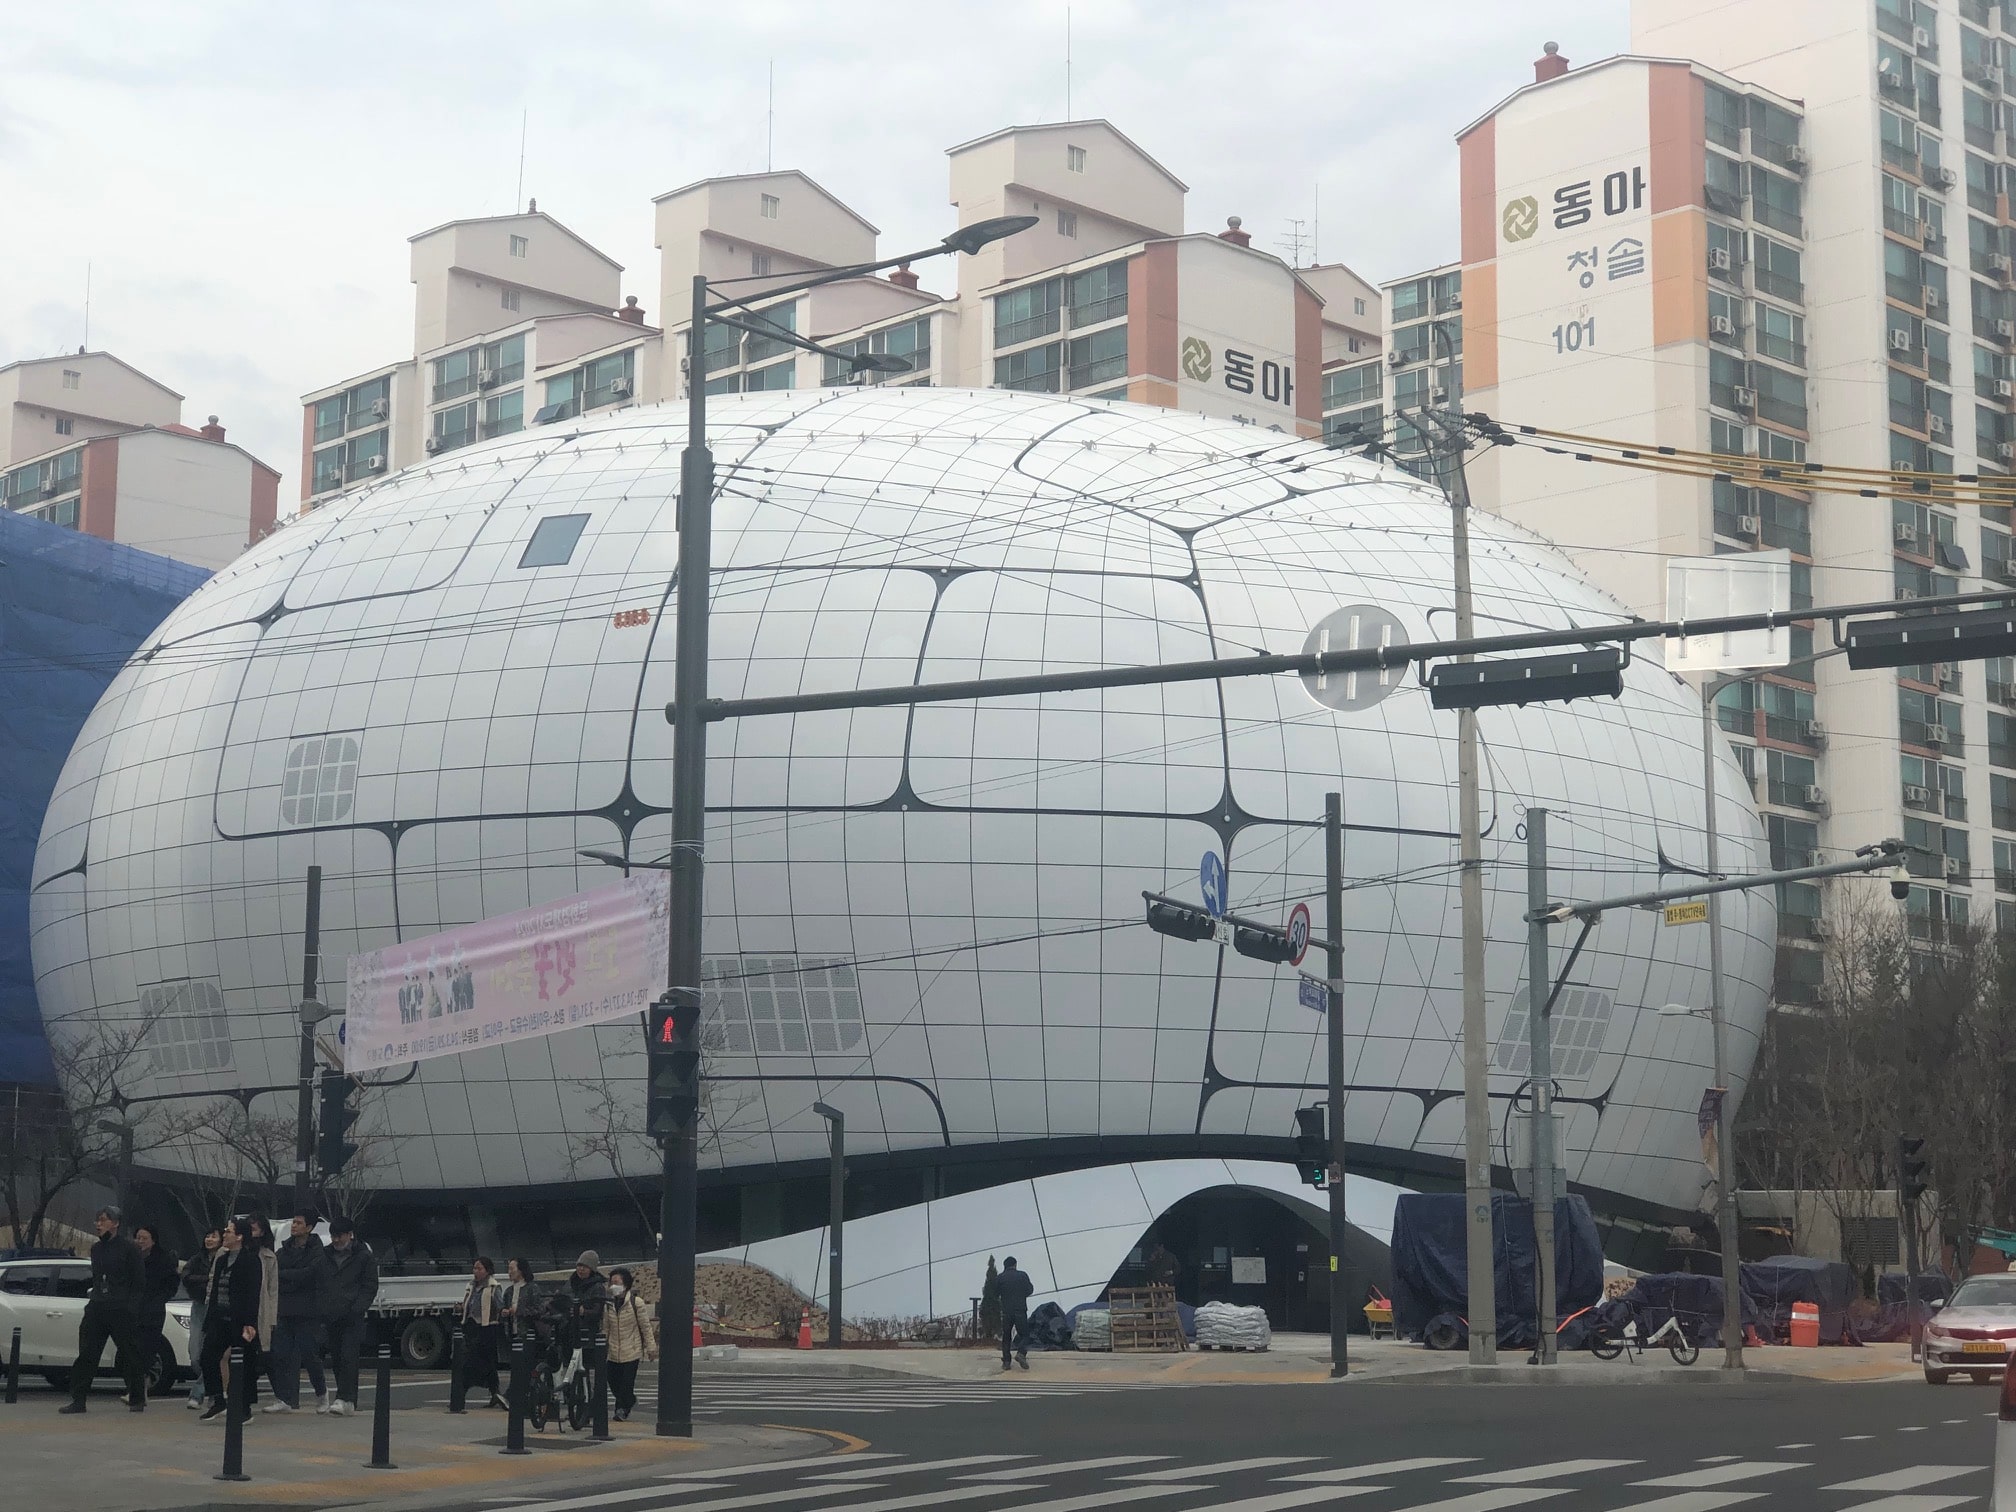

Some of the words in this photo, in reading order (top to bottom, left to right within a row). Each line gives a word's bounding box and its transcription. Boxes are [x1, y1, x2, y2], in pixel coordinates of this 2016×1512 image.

[1552, 166, 1647, 230] 동아
[1566, 237, 1645, 289] 청솔
[1552, 316, 1595, 354] 101
[1224, 348, 1294, 406] 동아
[1292, 920, 1306, 949] 30
